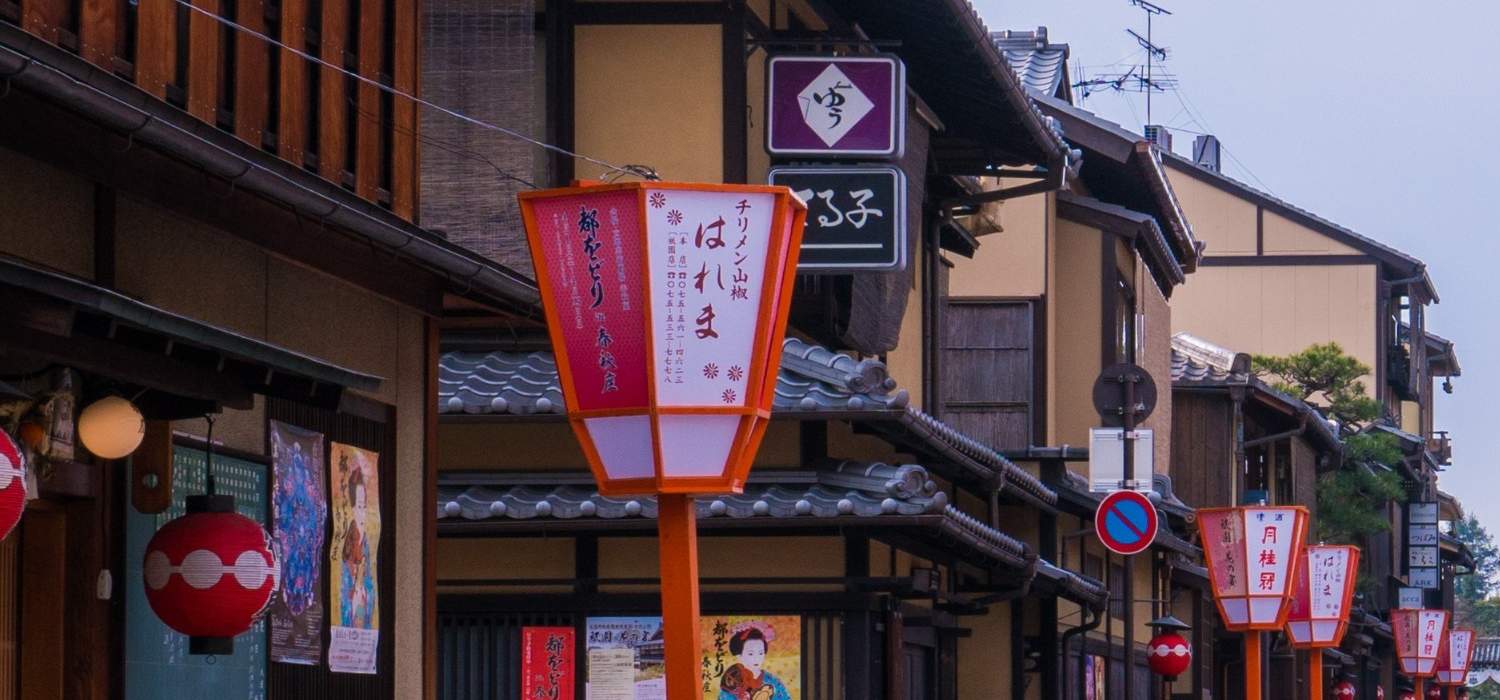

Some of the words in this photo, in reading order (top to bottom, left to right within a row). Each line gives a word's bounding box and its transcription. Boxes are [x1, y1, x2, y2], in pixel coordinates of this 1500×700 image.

[694, 216, 725, 339] はれま
[730, 199, 751, 300] チリメン山椒
[1259, 526, 1276, 590] 月桂冠
